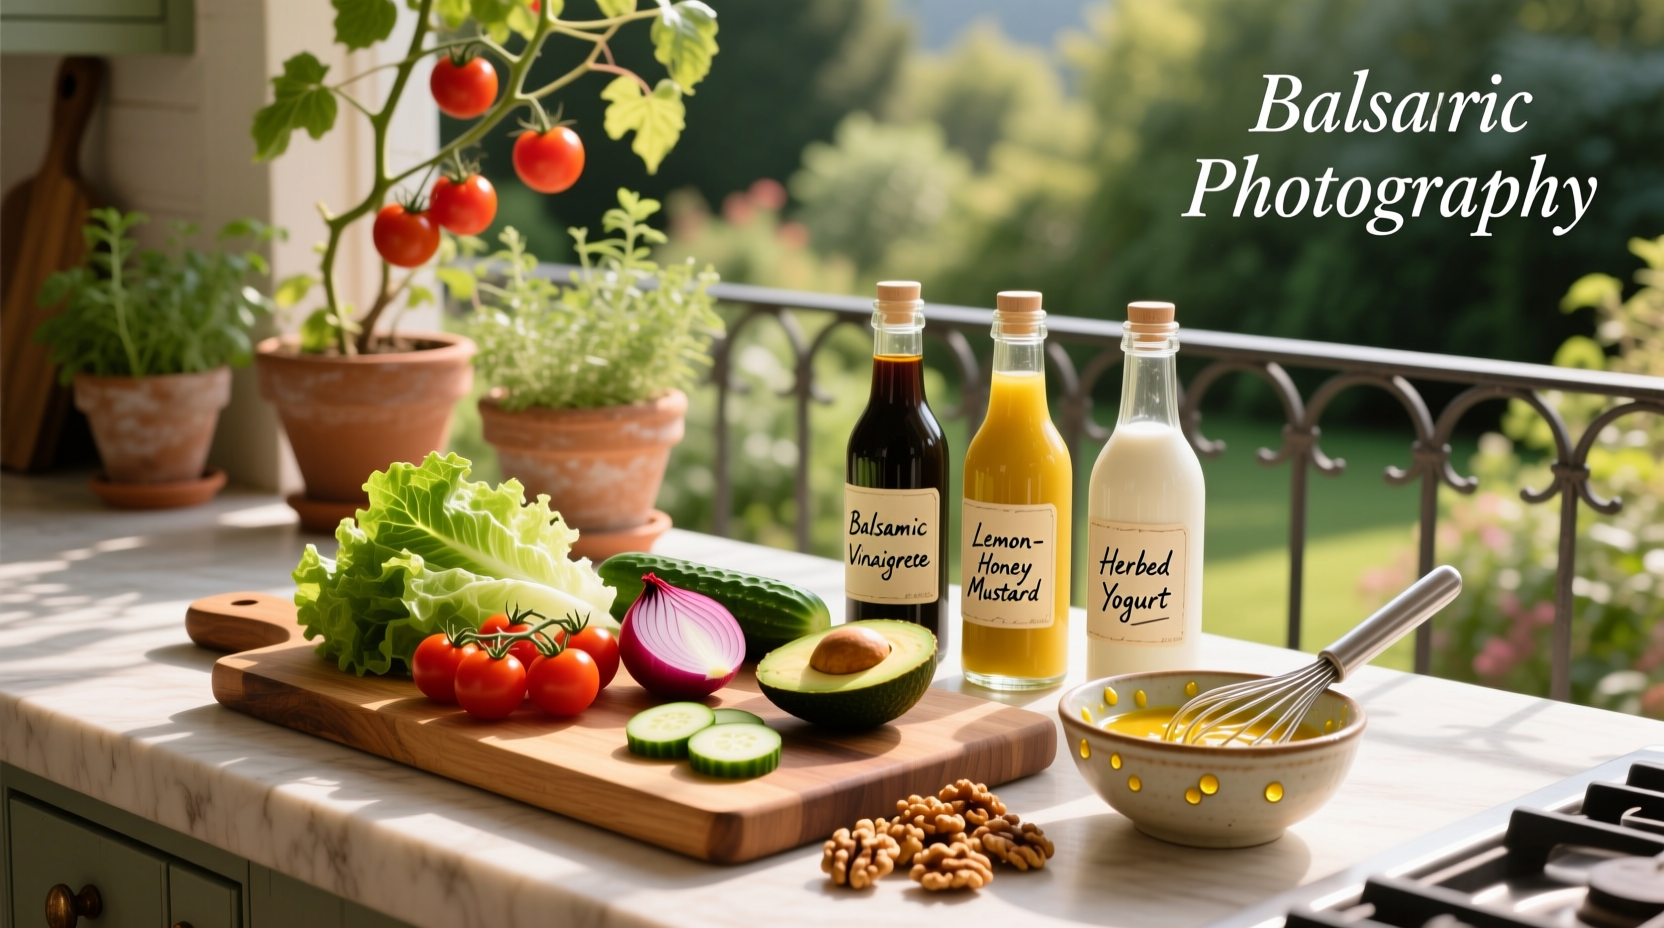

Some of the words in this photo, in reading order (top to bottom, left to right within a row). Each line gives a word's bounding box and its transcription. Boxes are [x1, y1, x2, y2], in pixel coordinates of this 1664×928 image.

[849, 510, 927, 536] Balsamic
[972, 522, 1044, 549] Lemon-
[978, 552, 1032, 586] Honey
[1099, 546, 1173, 576] Herbed
[967, 576, 1042, 601] Mustard
[1102, 581, 1171, 623] Yogurt
